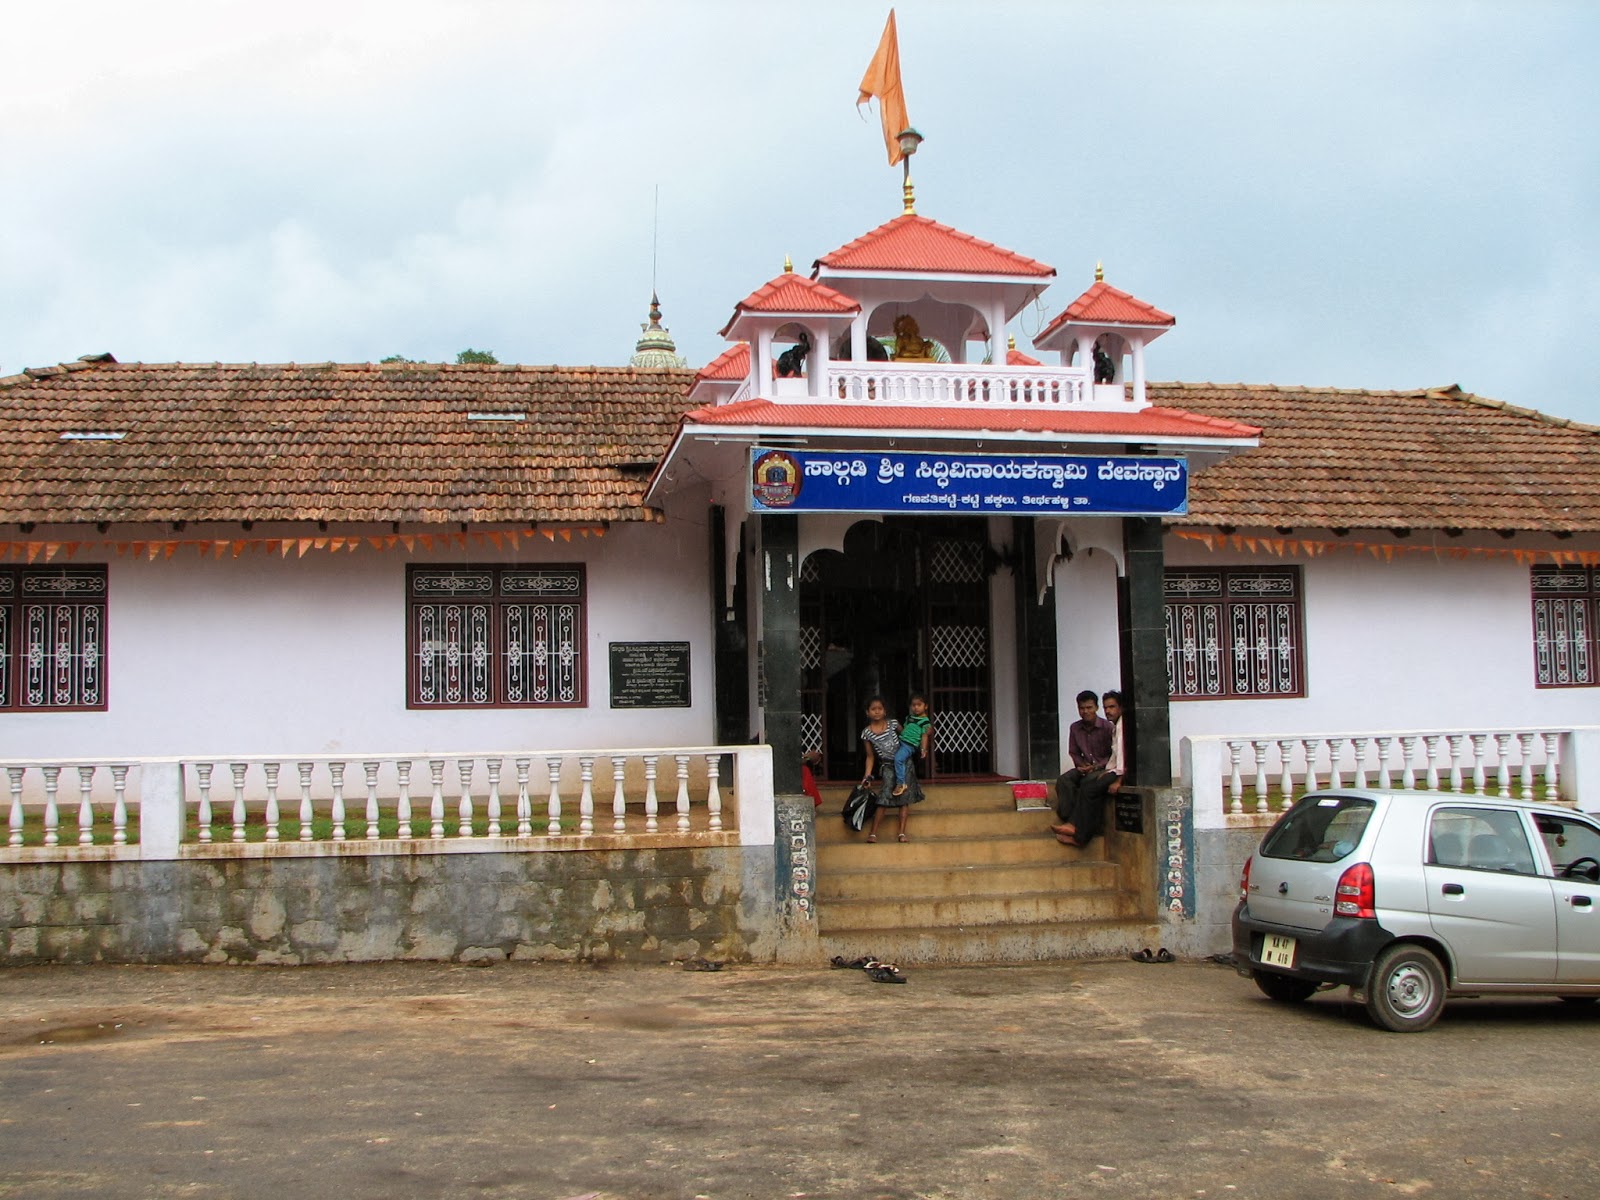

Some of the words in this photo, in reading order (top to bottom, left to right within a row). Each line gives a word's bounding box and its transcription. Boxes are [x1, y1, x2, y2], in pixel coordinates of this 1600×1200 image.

[805, 460, 868, 486] ಸಾಲ್ಗಡಿ
[876, 458, 905, 485] ಶ್ರೀ
[915, 460, 1088, 490] ಸಿದ್ಧಿವಿನಾಯಕಸ್ವಾಮಿ
[1097, 461, 1182, 492] ದೇವಸ್ಥಾನ
